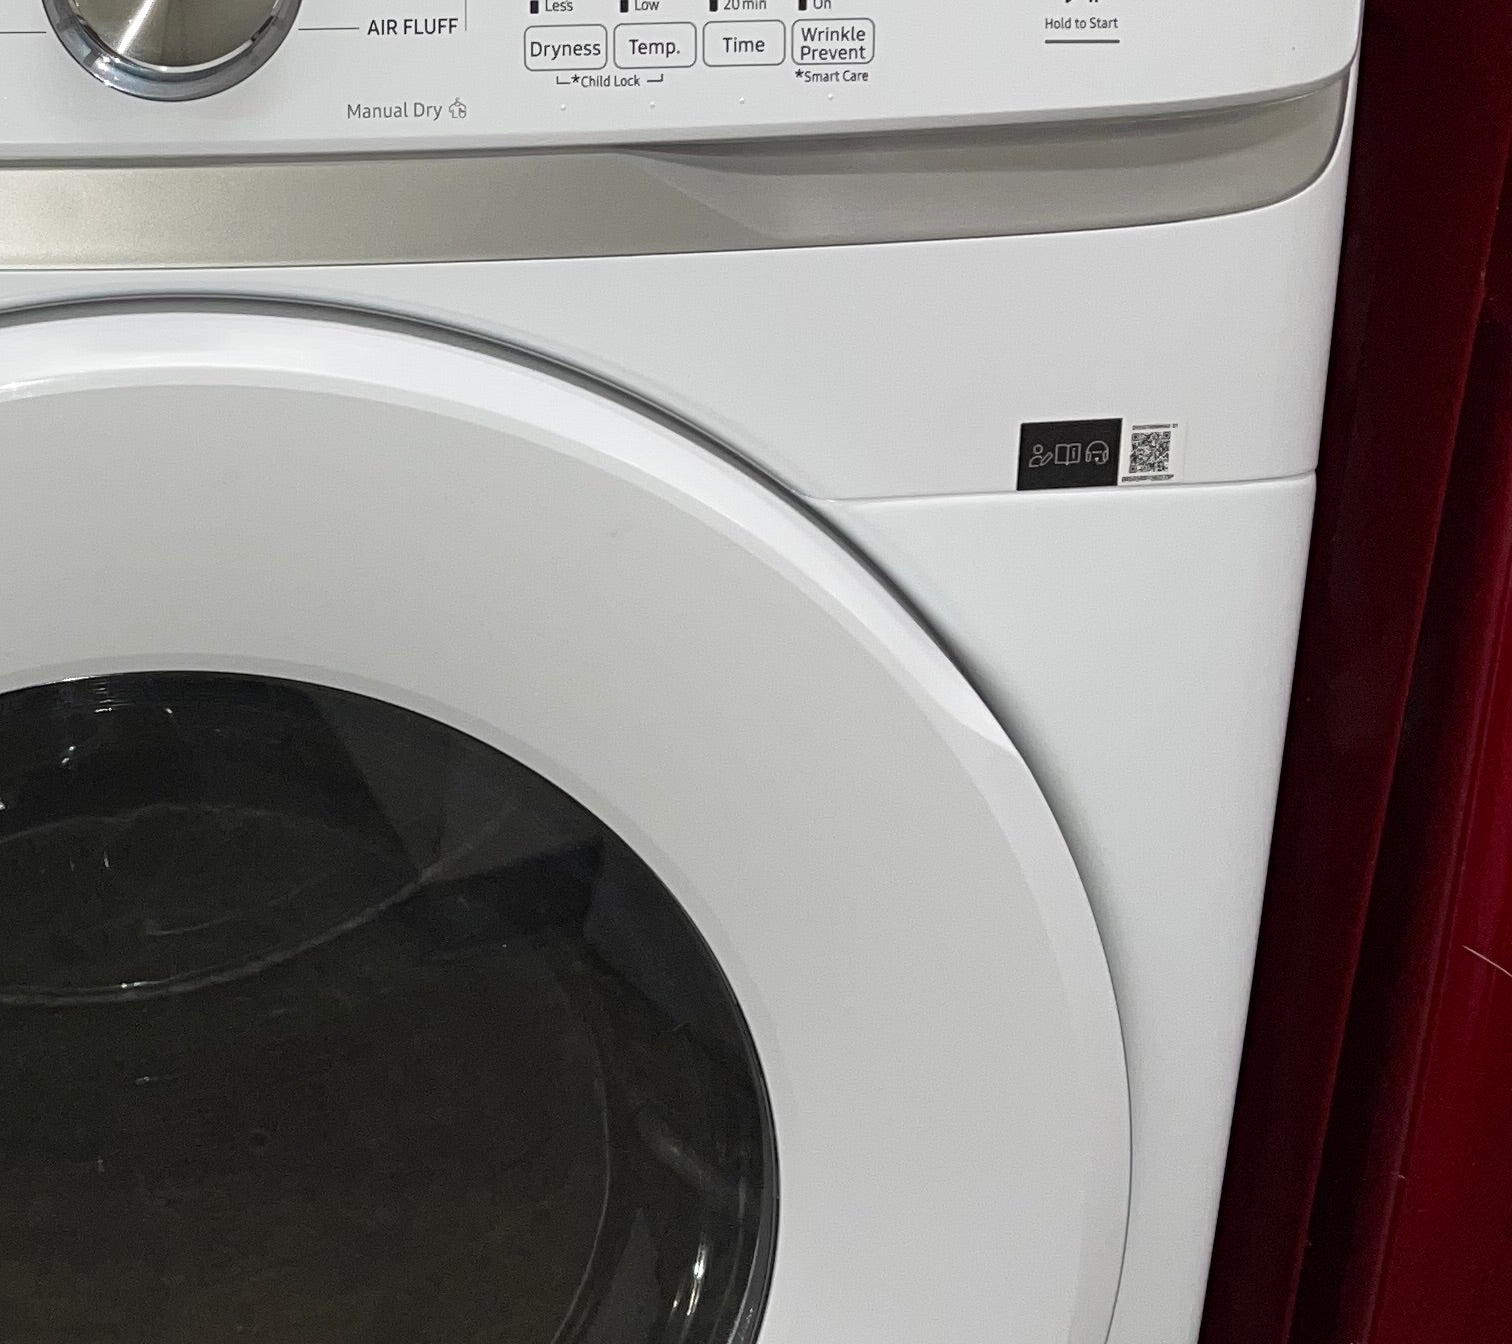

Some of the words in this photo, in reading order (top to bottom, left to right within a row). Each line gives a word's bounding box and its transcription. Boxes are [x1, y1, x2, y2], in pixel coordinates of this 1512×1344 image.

[545, 0, 574, 12] Less
[367, 19, 398, 36] AIR
[403, 17, 459, 35] FLUFF
[1044, 16, 1072, 30] Hold
[1074, 18, 1087, 30] to
[1089, 16, 1119, 29] Start
[800, 25, 866, 42] Wrinkle
[530, 41, 601, 61] Dryness
[628, 39, 681, 59] Temp.
[722, 36, 765, 53] Time
[799, 44, 867, 62] Prevent
[613, 74, 641, 88] Lock
[842, 69, 869, 82] Care
[347, 101, 403, 120] Manual
[406, 101, 443, 122] Dry
